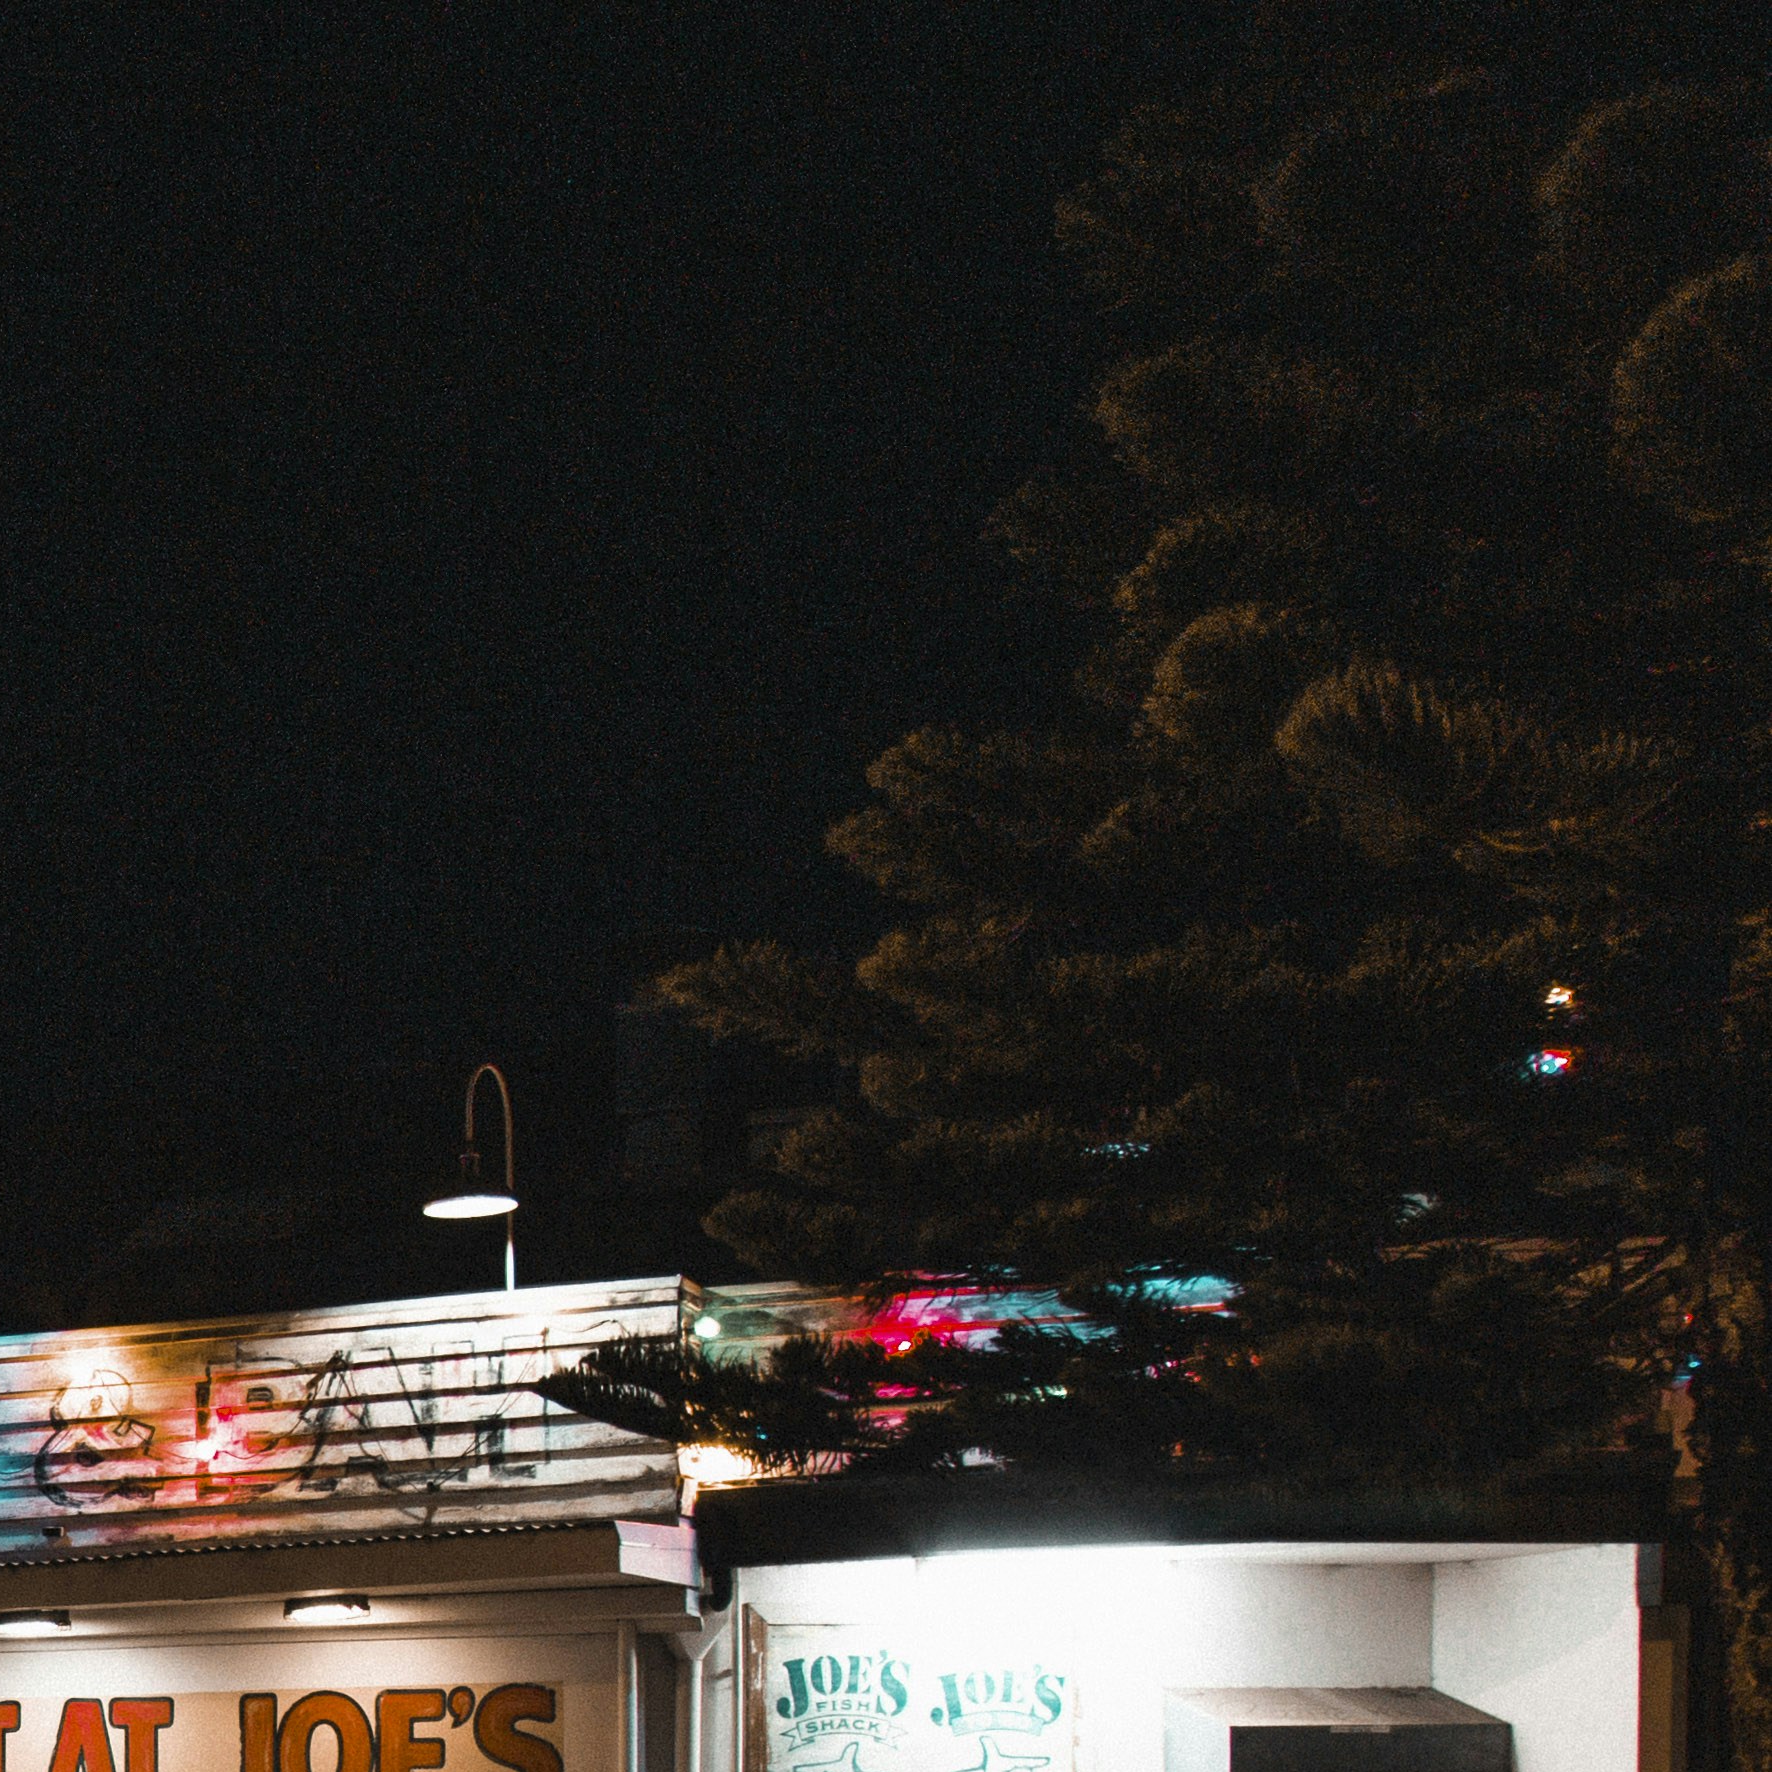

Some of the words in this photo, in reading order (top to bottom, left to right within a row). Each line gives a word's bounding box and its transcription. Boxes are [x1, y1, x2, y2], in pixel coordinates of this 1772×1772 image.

[776, 1650, 910, 1719] JOE'S
[930, 1664, 1065, 1727] JOE'S
[805, 1718, 880, 1734] SHACK
[816, 1699, 870, 1714] FISH
